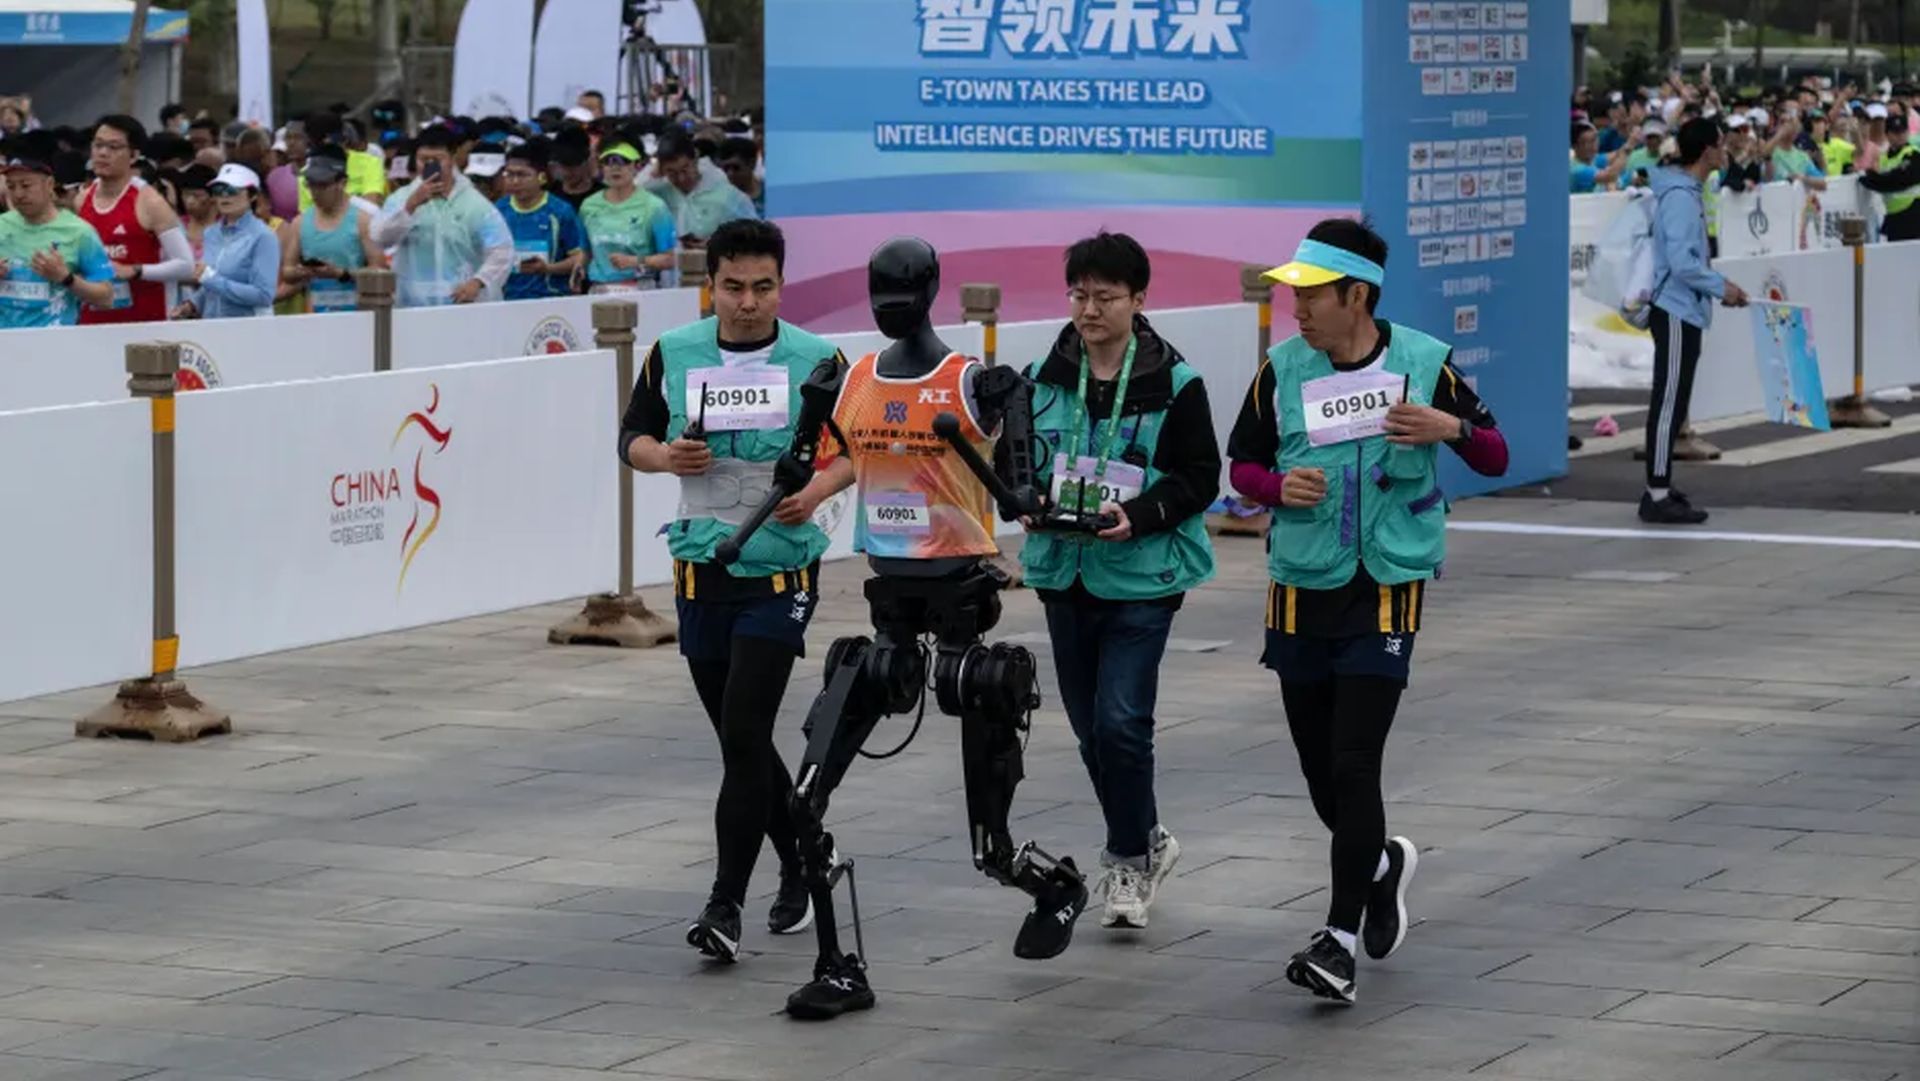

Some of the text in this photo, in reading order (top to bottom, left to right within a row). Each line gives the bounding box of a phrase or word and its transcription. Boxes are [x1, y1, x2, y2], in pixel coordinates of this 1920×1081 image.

[919, 0, 1245, 56] 智领未来
[920, 79, 1205, 103] E-TOWN TAKES THE LEAD
[875, 125, 1267, 150] INTELLIGENCE DRIVES THE FUTURE
[703, 388, 771, 407] 60901
[1321, 390, 1390, 419] 60901
[331, 467, 402, 507] CHINA
[330, 505, 384, 526] MARATHON
[877, 506, 918, 520] 60901
